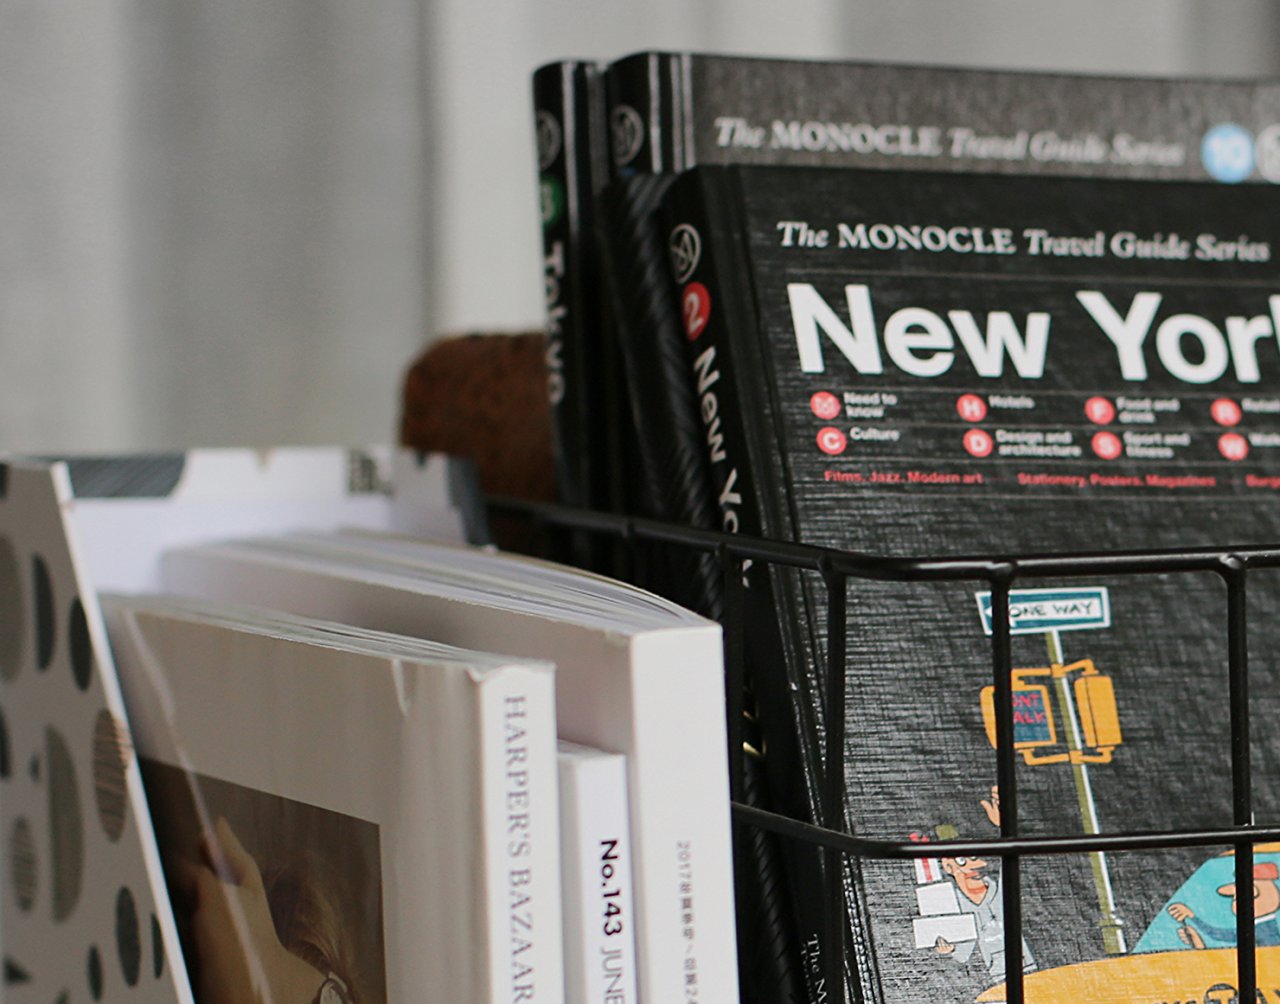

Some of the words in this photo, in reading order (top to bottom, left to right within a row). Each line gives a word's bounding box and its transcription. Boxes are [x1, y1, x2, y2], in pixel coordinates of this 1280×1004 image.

[714, 116, 768, 149] The
[771, 119, 943, 157] MONOCLE
[947, 127, 1029, 161] Travel
[1029, 130, 1107, 163] Guide
[1110, 133, 1186, 167] Series
[776, 220, 830, 249] The
[836, 222, 1018, 255] MONOCLE
[1023, 228, 1106, 258] Travel
[1110, 231, 1191, 262] Guide
[1195, 233, 1272, 263] Series
[787, 283, 1051, 378] New
[693, 345, 727, 464] New
[822, 431, 845, 450] C
[849, 427, 900, 442] Culture
[907, 472, 961, 485] Modern
[963, 473, 984, 485] art
[1052, 601, 1093, 616] WAY
[503, 694, 531, 859] HARPER'S
[599, 838, 624, 938] No.143
